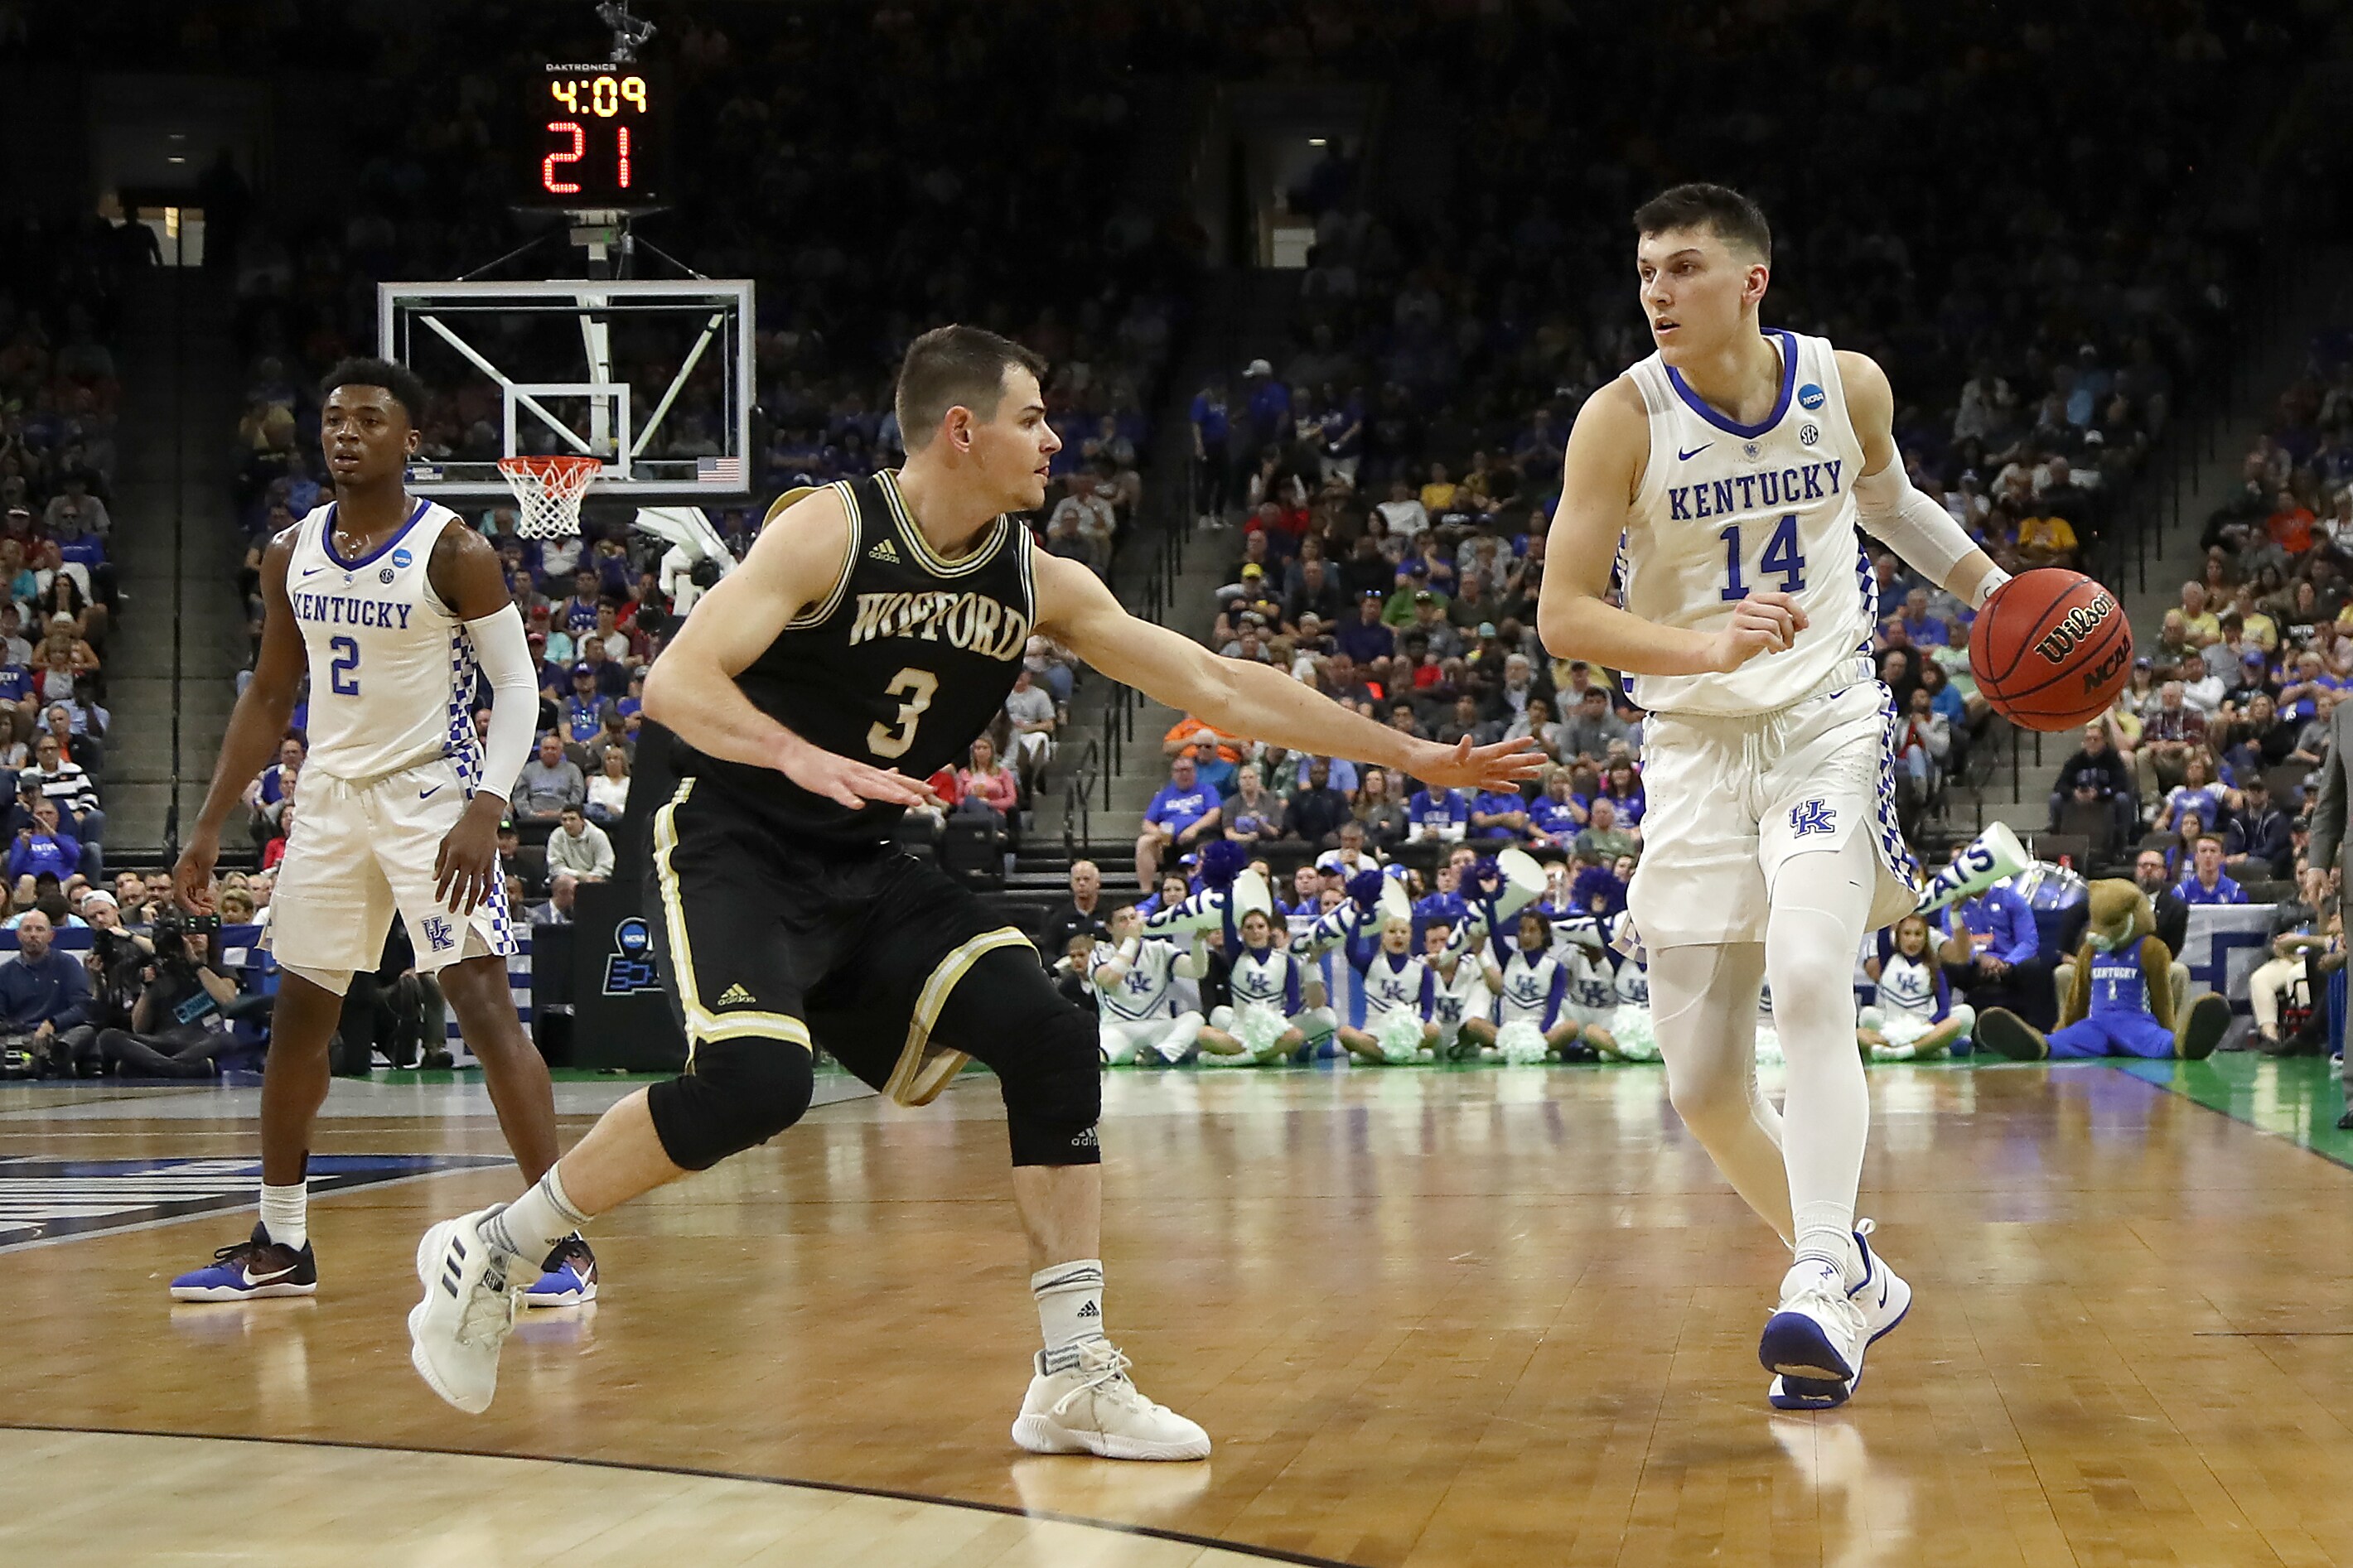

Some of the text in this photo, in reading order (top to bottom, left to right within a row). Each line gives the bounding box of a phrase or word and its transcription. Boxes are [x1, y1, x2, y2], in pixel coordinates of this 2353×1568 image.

[545, 63, 617, 72] DAKTRONICS
[552, 76, 646, 118] 4:09
[542, 121, 631, 194] 21
[1803, 393, 1824, 406] NCAA
[1801, 426, 1817, 444] SEC
[1668, 460, 1842, 520] KENTUCKY
[868, 550, 901, 565] adidas
[1719, 514, 1806, 601] 14
[293, 591, 412, 630] KENTUCKY
[848, 591, 1027, 663] WOFFORD
[2033, 591, 2117, 664] Wilson
[330, 635, 360, 696] 2
[2083, 634, 2131, 695] NCAA
[866, 667, 939, 760] 3
[1790, 798, 1837, 838] UK
[422, 916, 454, 952] UK
[2092, 967, 2138, 980] KENTUCKY
[717, 996, 756, 1006] adidas
